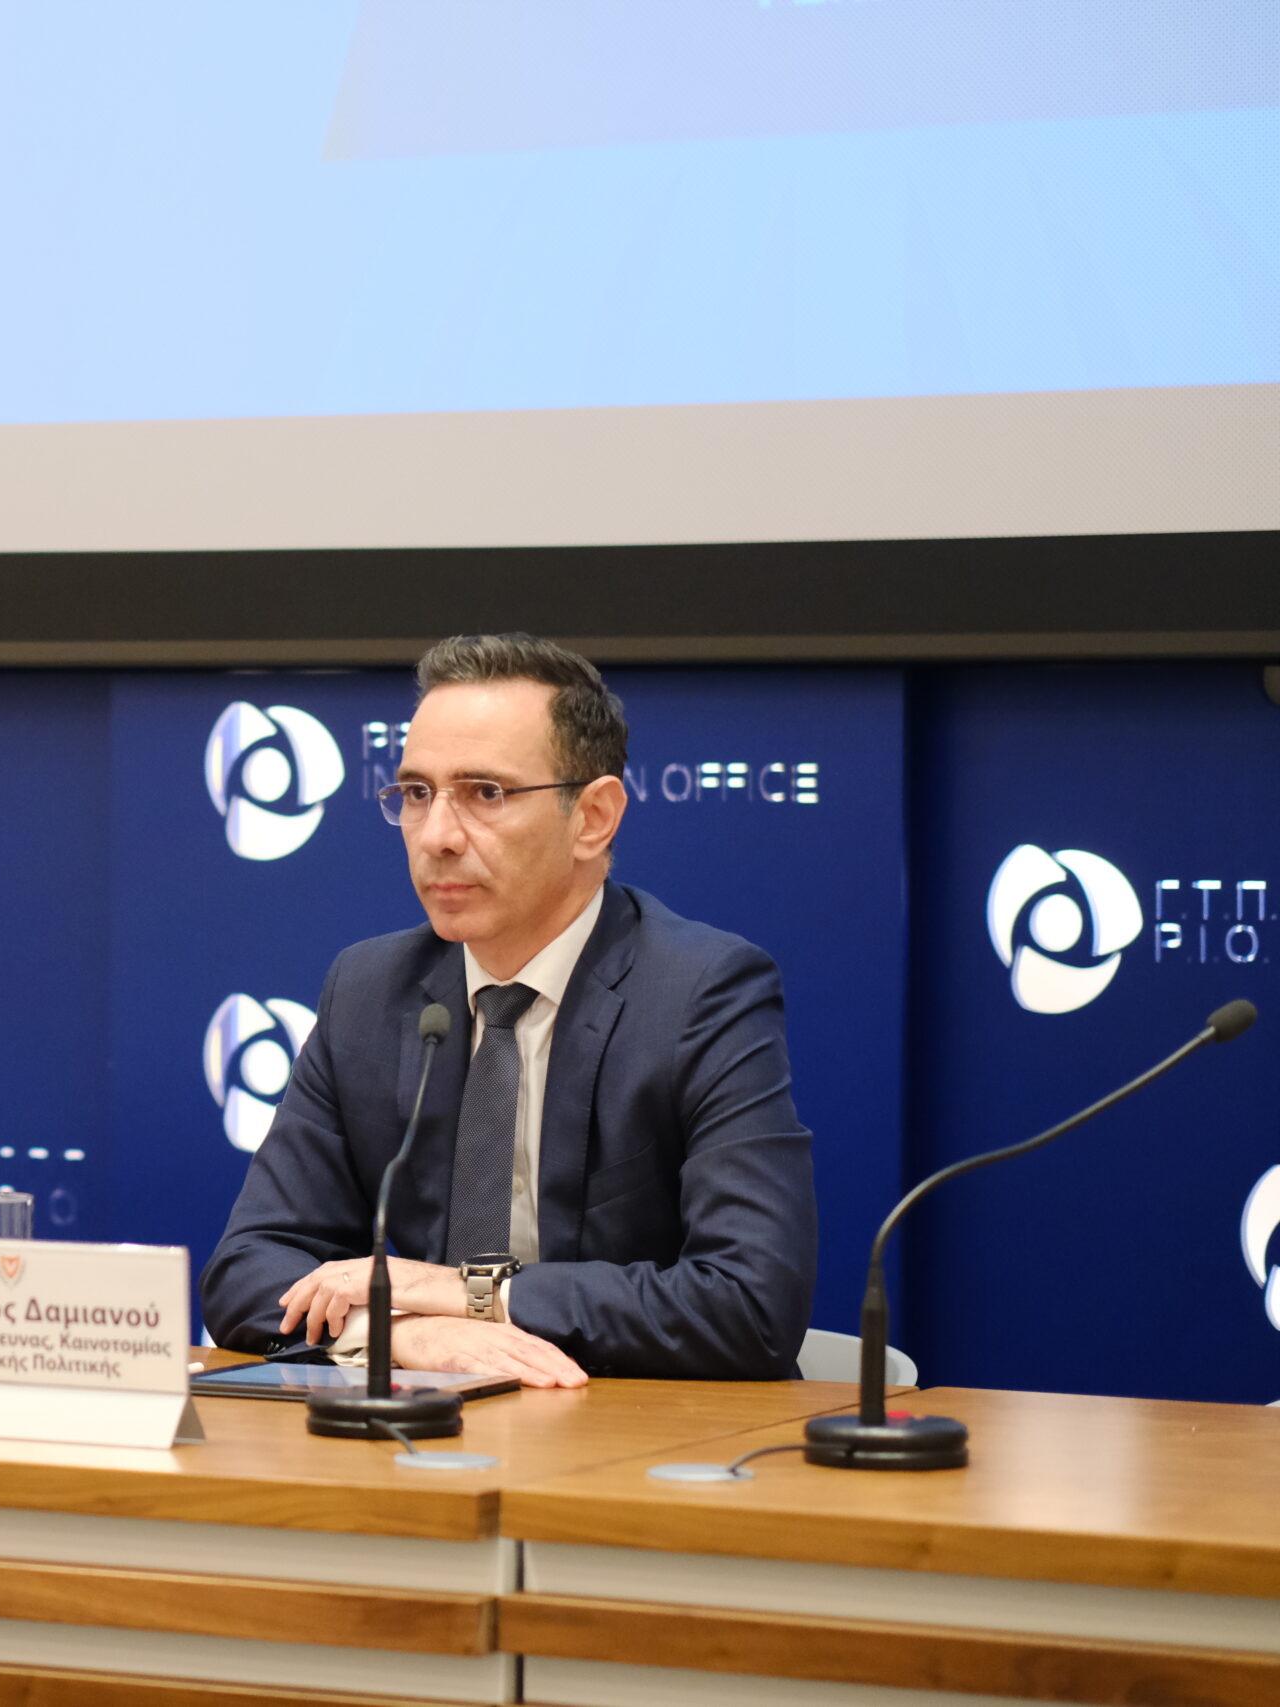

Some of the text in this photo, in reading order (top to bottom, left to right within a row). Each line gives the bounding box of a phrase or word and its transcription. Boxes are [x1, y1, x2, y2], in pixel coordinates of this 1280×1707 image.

[662, 762, 819, 804] OFFICE
[24, 1297, 160, 1329] Δαμιανού
[59, 1333, 172, 1358] Καινοτομίας
[33, 1353, 121, 1378] Πολιτικής
